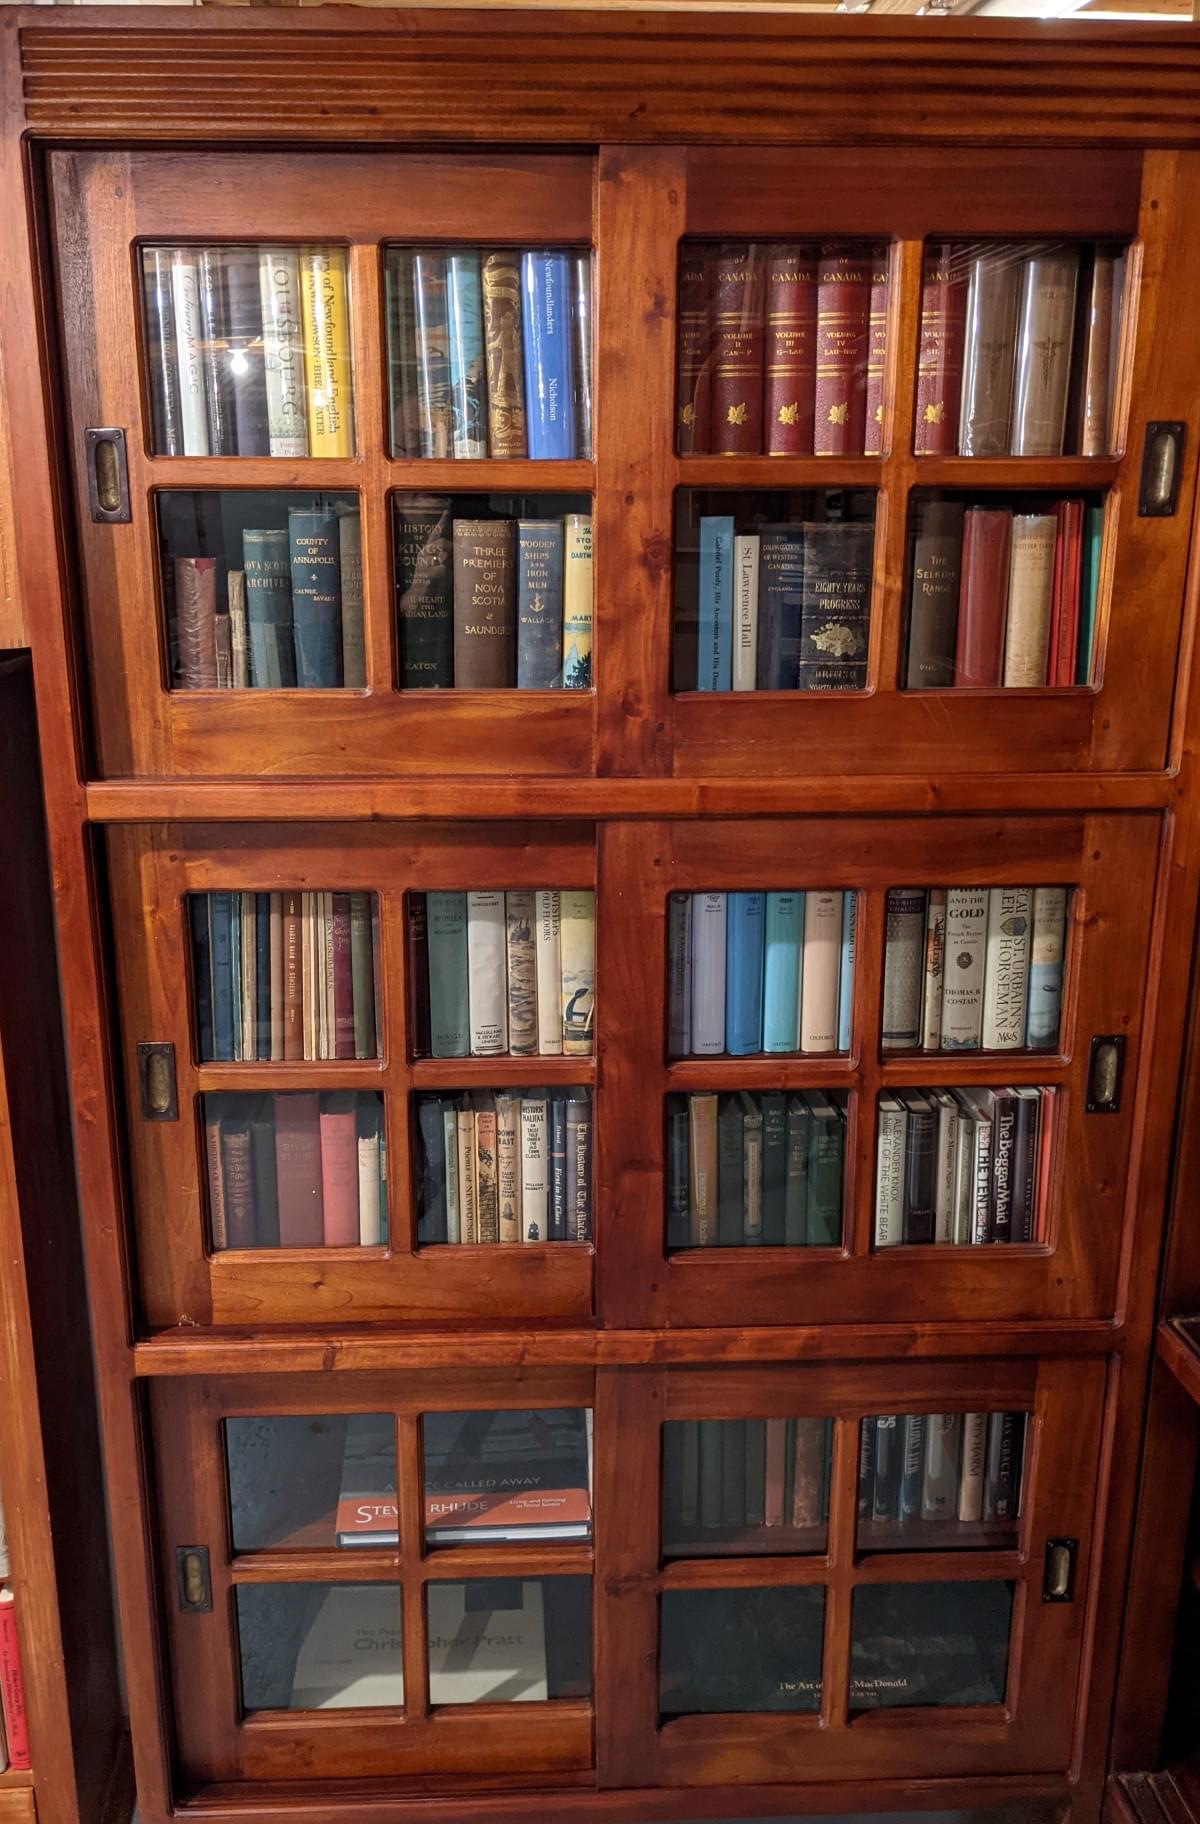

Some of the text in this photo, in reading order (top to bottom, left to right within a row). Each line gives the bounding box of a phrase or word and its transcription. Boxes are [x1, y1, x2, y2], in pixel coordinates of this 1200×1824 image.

[718, 272, 758, 281] CANADA
[772, 272, 811, 282] CANADA
[823, 272, 862, 282] CANADA
[544, 259, 555, 335] Newfoundlanders
[324, 277, 340, 434] of Newfoundland English
[187, 337, 199, 394] MAGIC
[548, 378, 558, 421] Nicholson
[398, 543, 444, 554] KINGS
[519, 540, 555, 548] WOODEN
[473, 547, 507, 556] THREE
[524, 552, 550, 560] SHIPS
[293, 556, 335, 564] ANNAPOLIS
[483, 572, 497, 580] OF
[475, 584, 504, 593] NOVA
[528, 581, 548, 589] MEN
[815, 583, 840, 594] EIGHTY
[472, 596, 505, 605] SCOTIA
[741, 547, 753, 648] St Lawrence Hall
[819, 599, 860, 609] PROGRESS
[949, 908, 985, 919] GOLD
[543, 911, 551, 941] FLOORS
[995, 939, 1013, 1028] HORSEMAN
[1008, 938, 1025, 1029] ST. URBAIN'S
[522, 1114, 544, 1122] HALIFAX
[576, 1123, 587, 1208] The History of The
[890, 1118, 902, 1202] ALEXANDER KNOX
[466, 1174, 473, 1182] of
[554, 1167, 562, 1184] First
[879, 1117, 892, 1241] NIGHT OF THE WHITE BEAR
[554, 1195, 562, 1204] Its
[554, 1206, 562, 1225] Class
[969, 1440, 984, 1477] HARM
[1000, 1439, 1011, 1479] GRACE
[500, 1476, 541, 1487] AWAY
[430, 1501, 488, 1513] RHUDE
[779, 1678, 907, 1690] The Art MacDonald
